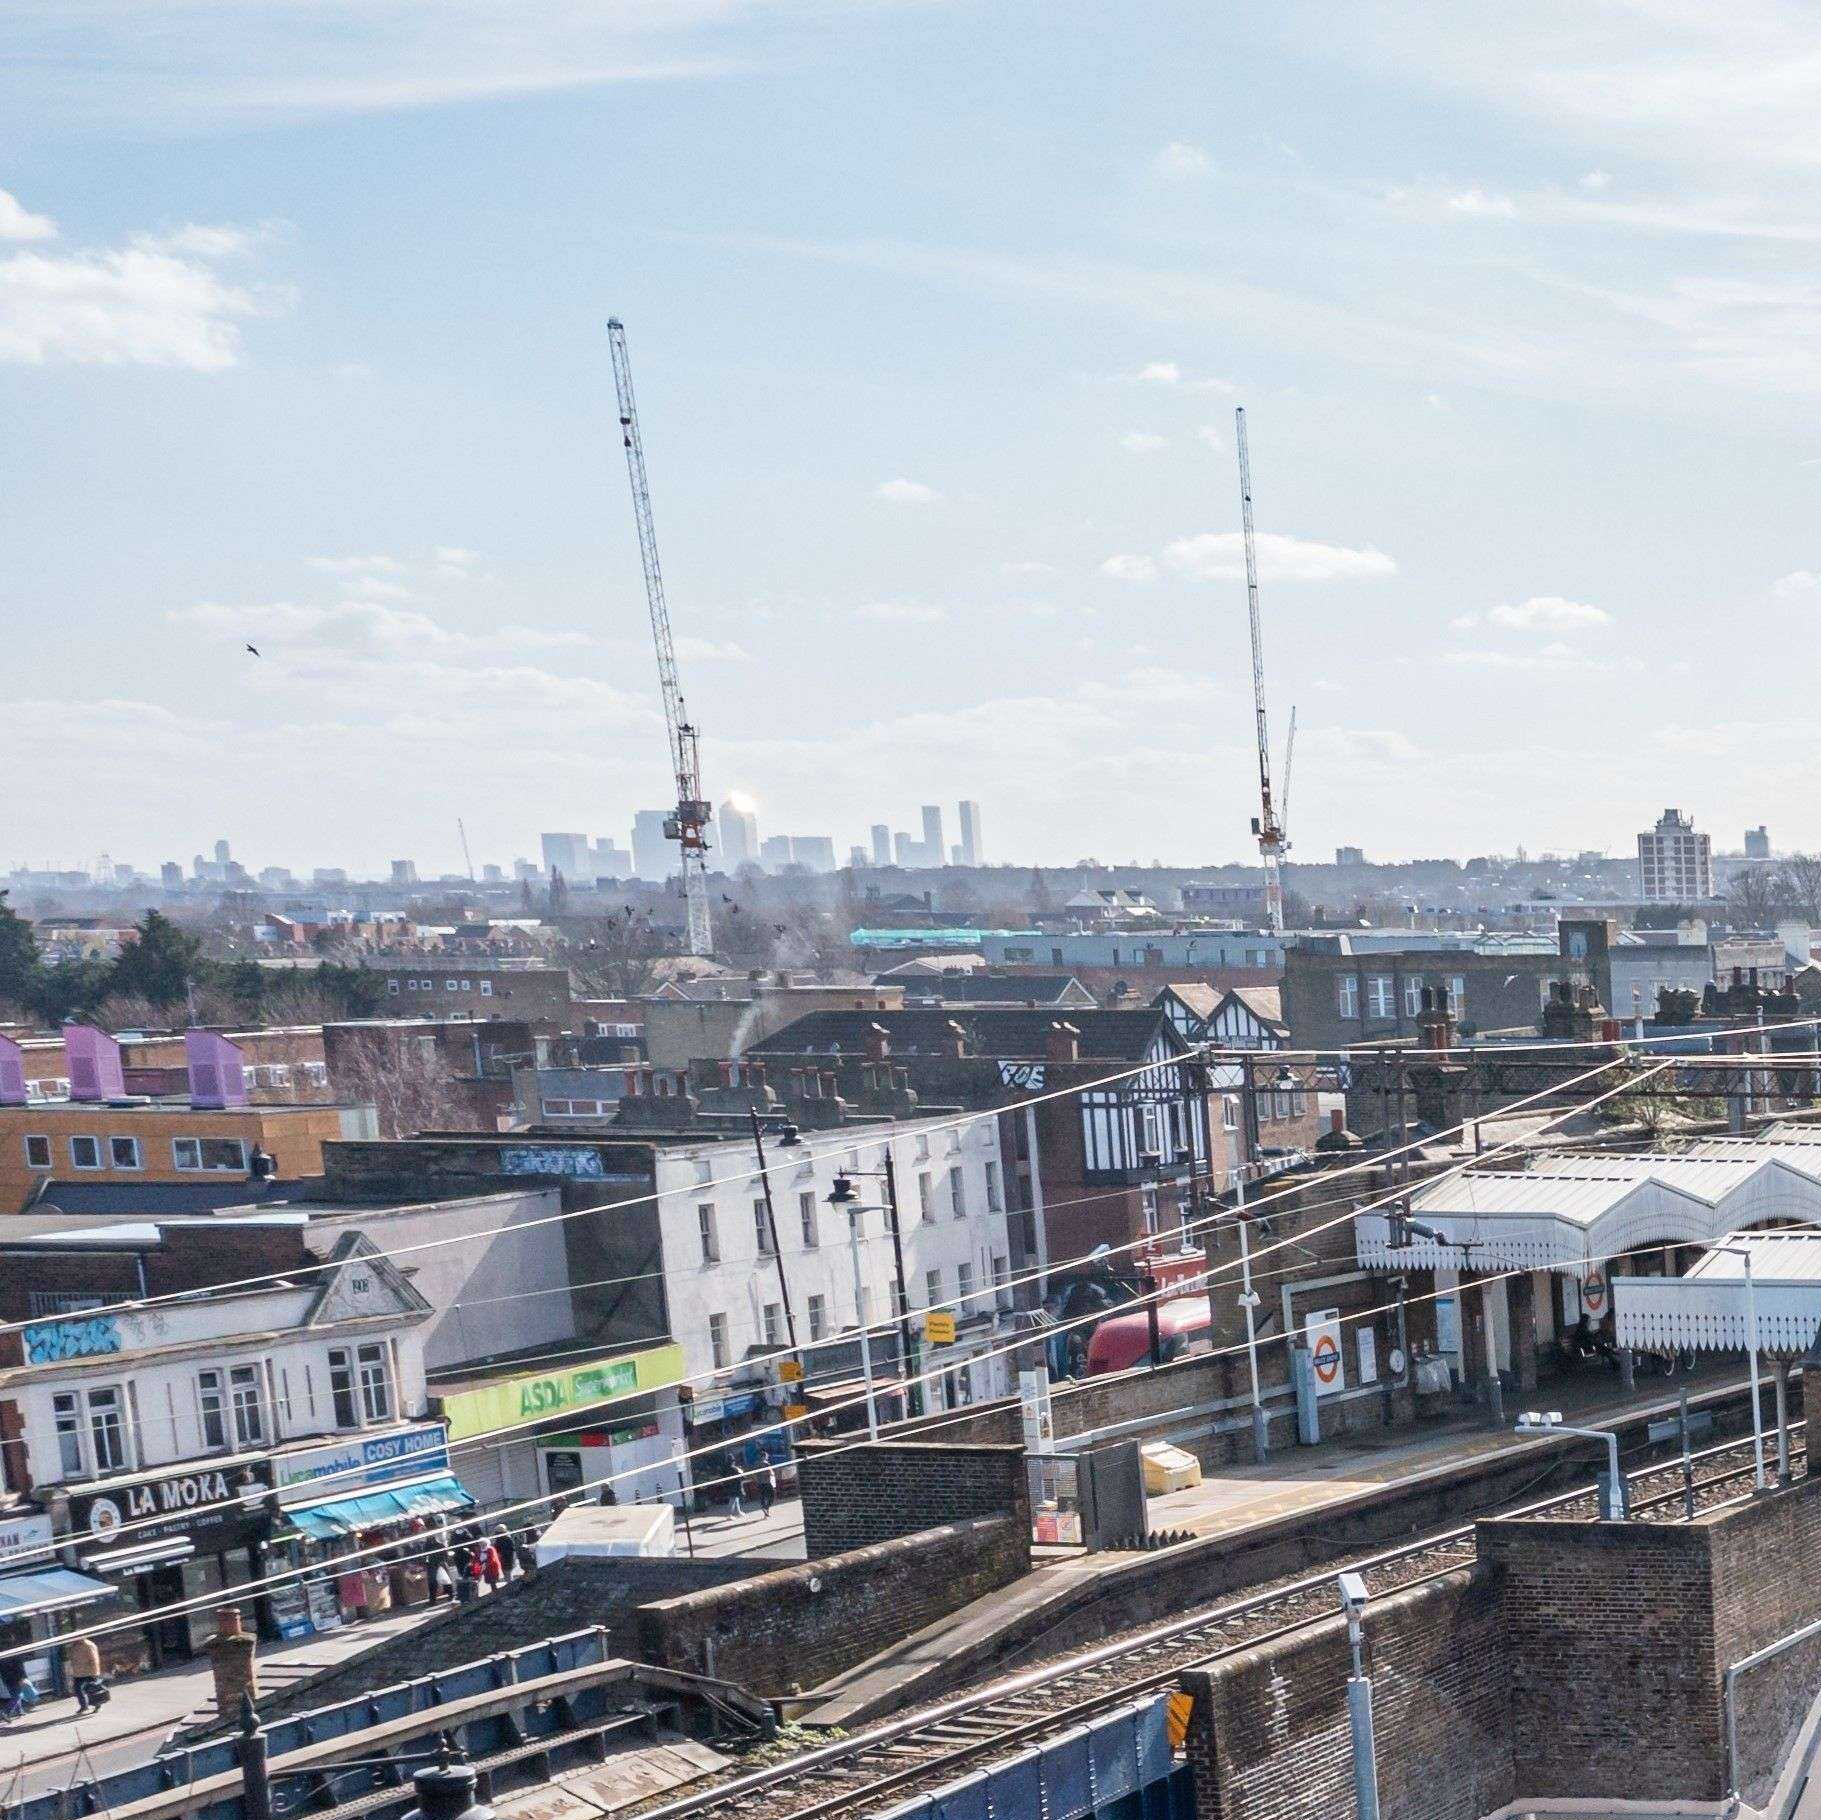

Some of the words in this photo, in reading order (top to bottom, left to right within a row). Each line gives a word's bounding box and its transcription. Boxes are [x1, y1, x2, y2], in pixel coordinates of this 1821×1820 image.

[366, 1441, 400, 1461] COSY
[404, 1431, 443, 1453] HOME
[127, 1487, 156, 1517] LA
[161, 1472, 229, 1511] MOKA
